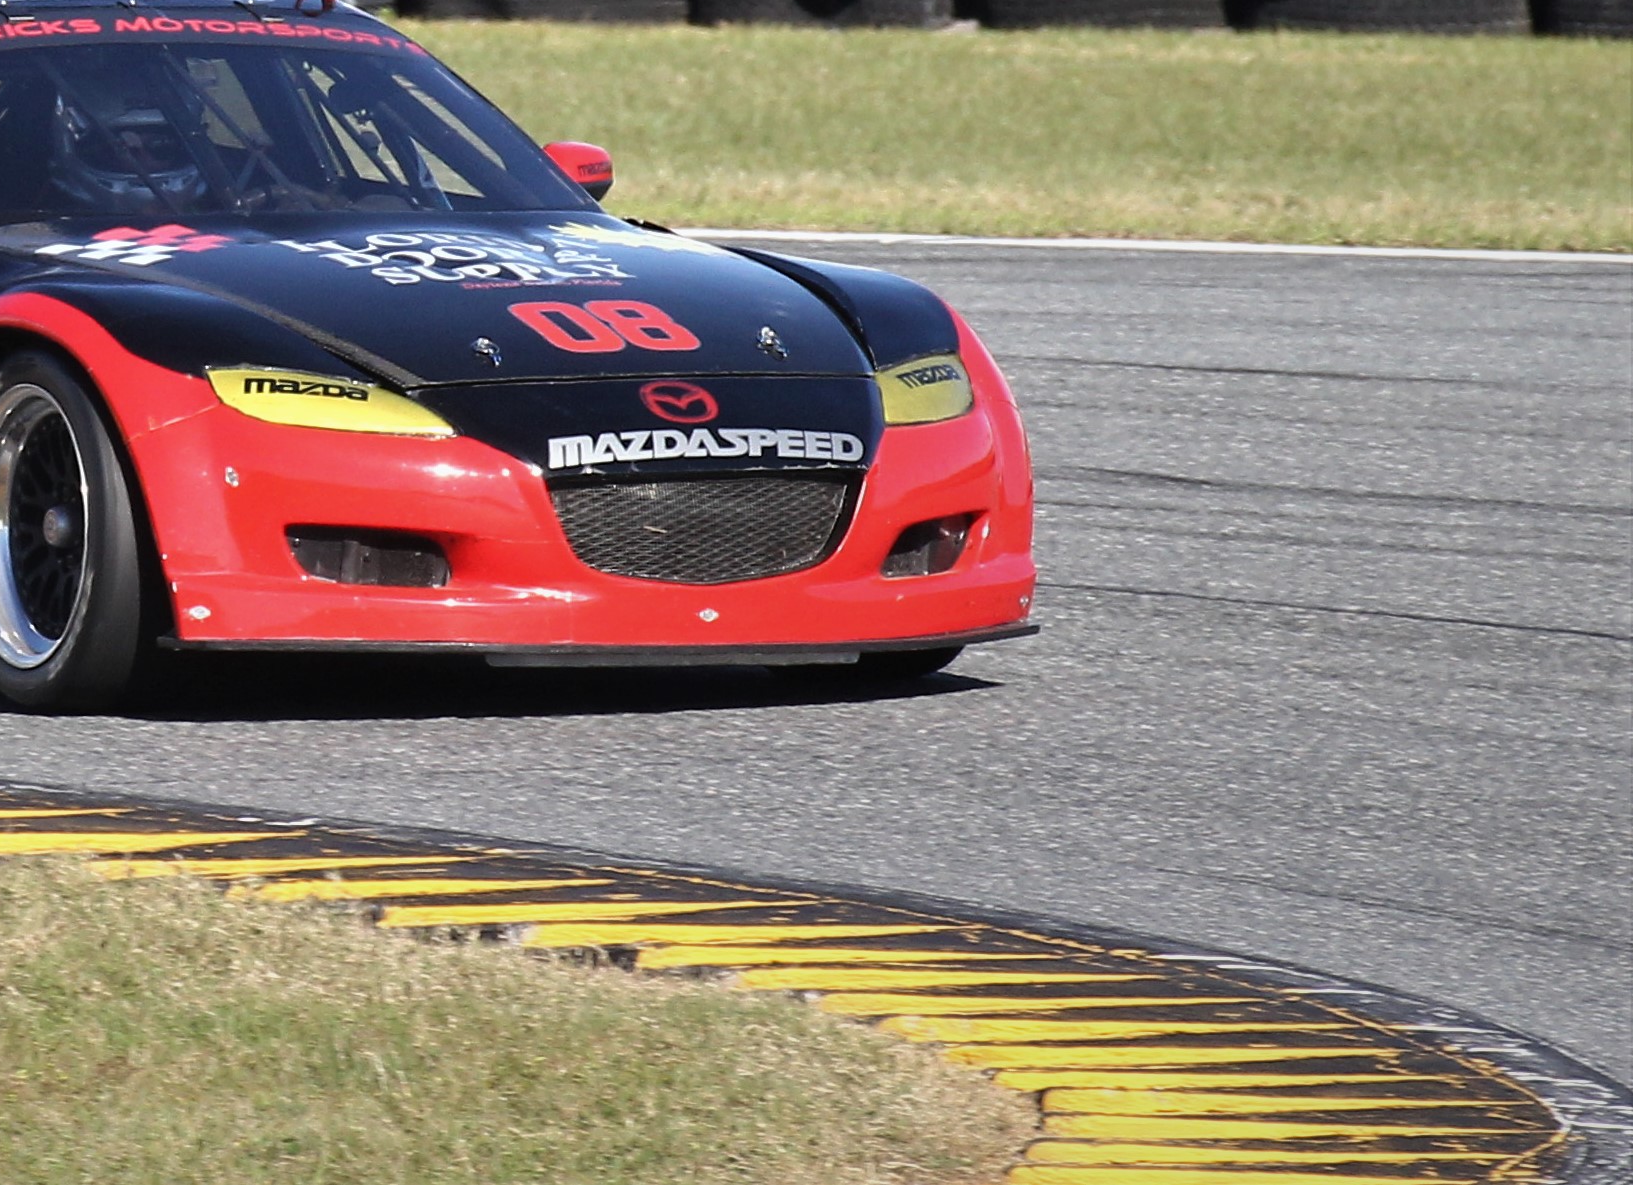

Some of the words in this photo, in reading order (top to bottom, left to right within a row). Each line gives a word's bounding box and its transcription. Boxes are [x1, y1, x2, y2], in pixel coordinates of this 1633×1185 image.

[320, 245, 548, 269] DOOR
[370, 262, 637, 285] SUPPLY
[506, 299, 702, 354] 08
[243, 377, 369, 402] mazda
[547, 428, 865, 469] MAZDASPEED
